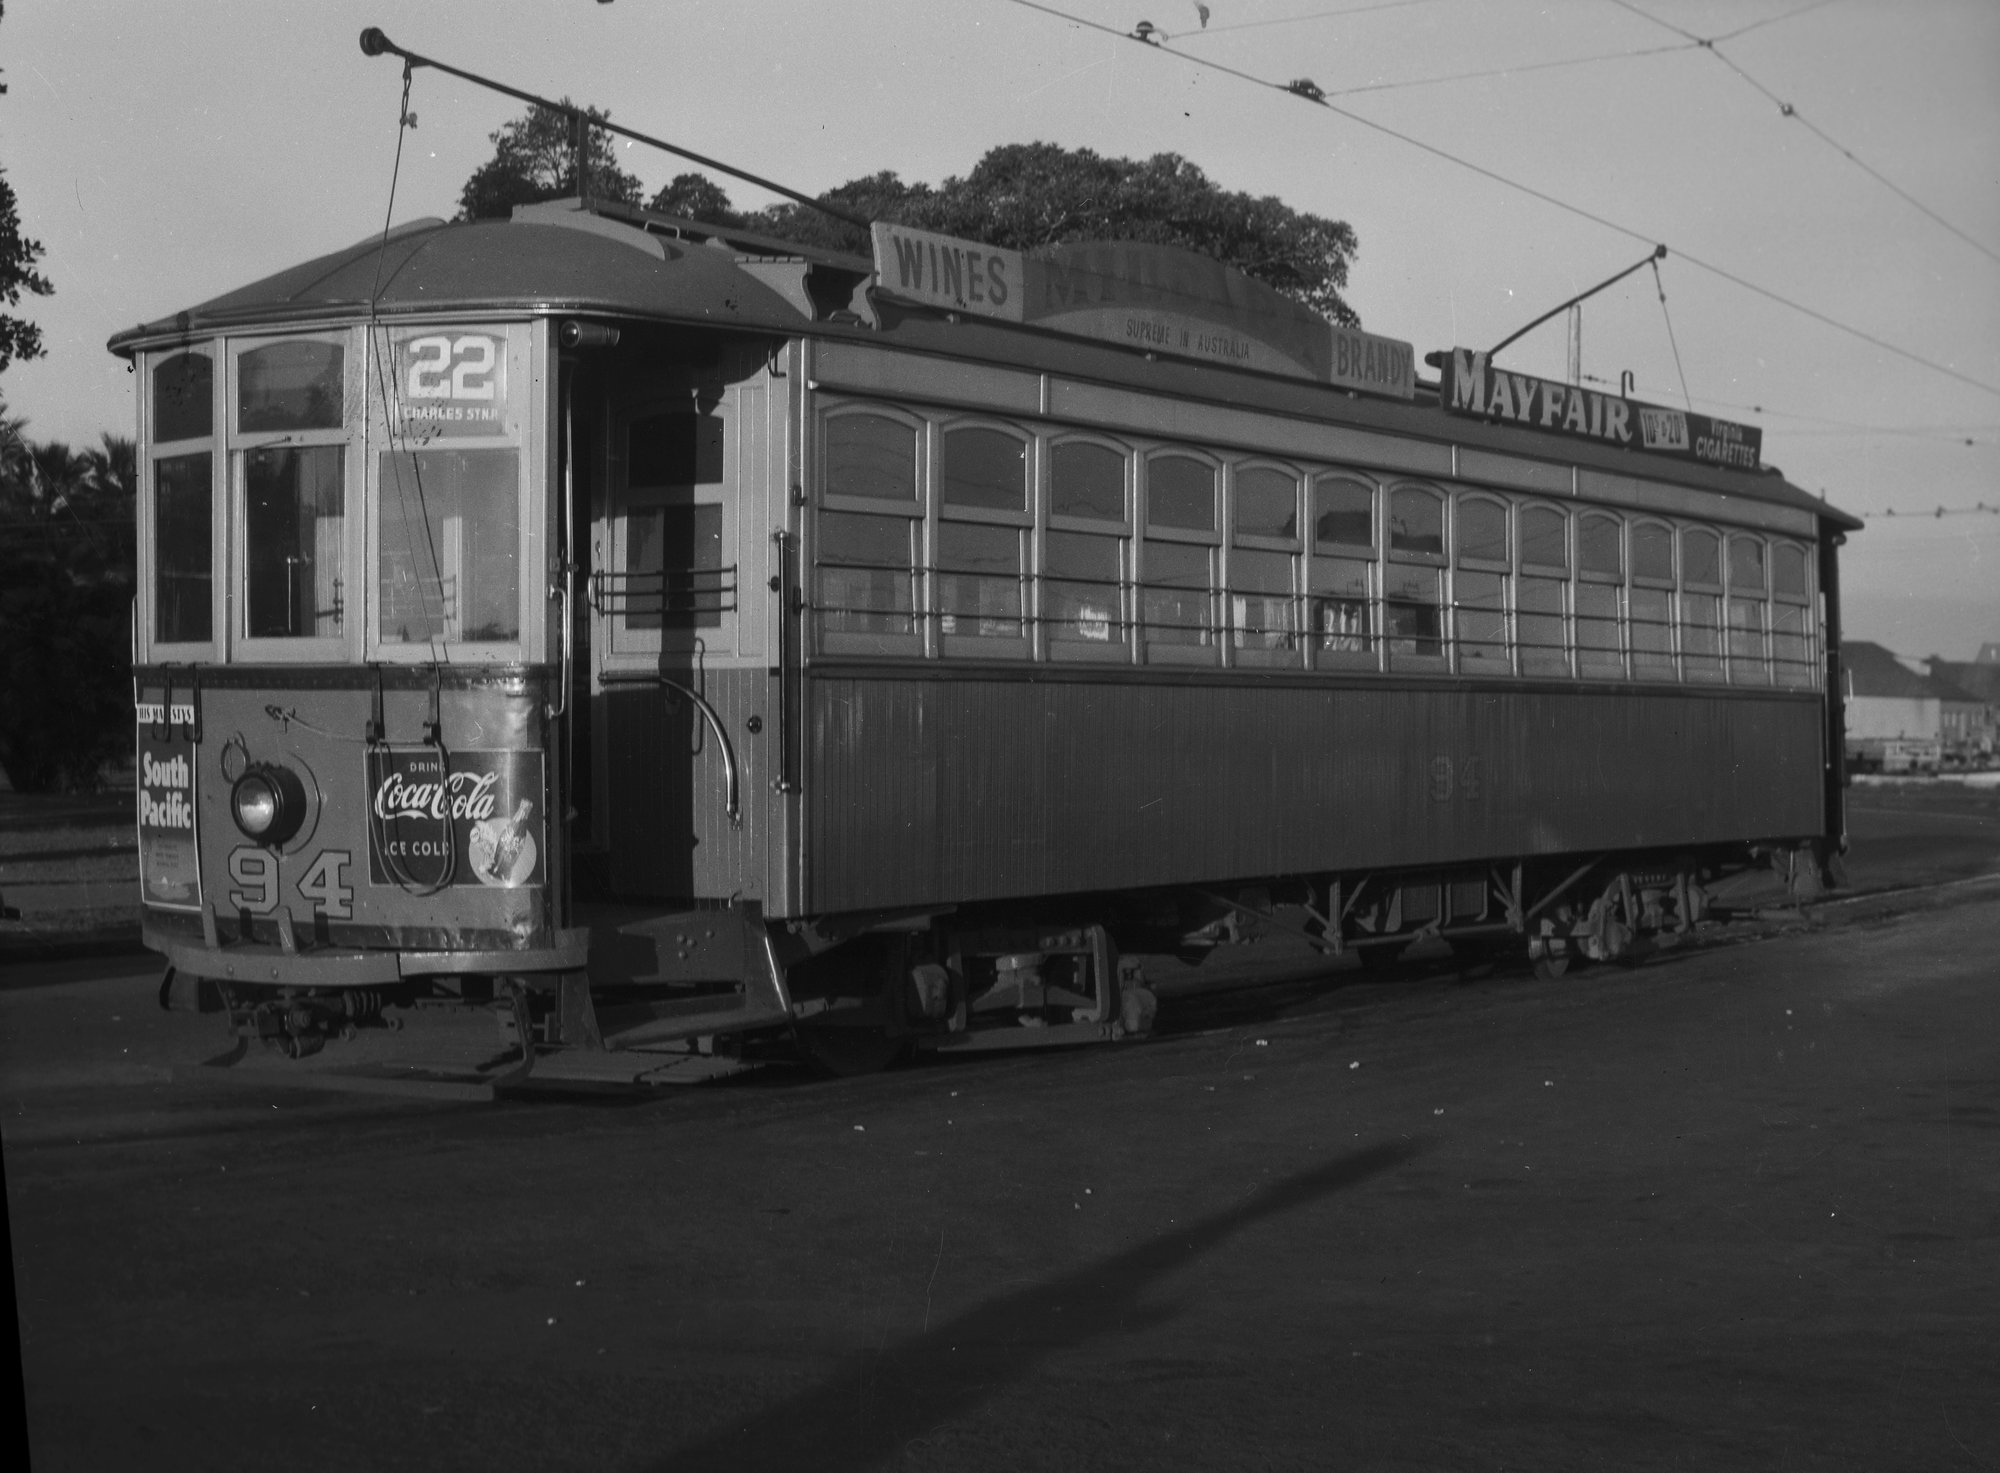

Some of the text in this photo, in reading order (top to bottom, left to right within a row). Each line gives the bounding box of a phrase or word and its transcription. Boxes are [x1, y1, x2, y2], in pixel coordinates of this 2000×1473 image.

[893, 234, 1008, 306] WINES
[1127, 318, 1249, 360] SUPREME IN AUSTRALIA
[1337, 333, 1411, 387] BRANDY
[408, 335, 496, 400] 22
[403, 406, 463, 421] CHARLES
[1451, 350, 1634, 443] MAYFAIR
[1695, 436, 1756, 468] CIGARETTES
[143, 750, 189, 789] South
[1430, 755, 1481, 801] 94
[140, 789, 192, 829] Pacific
[375, 771, 500, 820] Coca-Cola
[228, 845, 354, 920] 94
